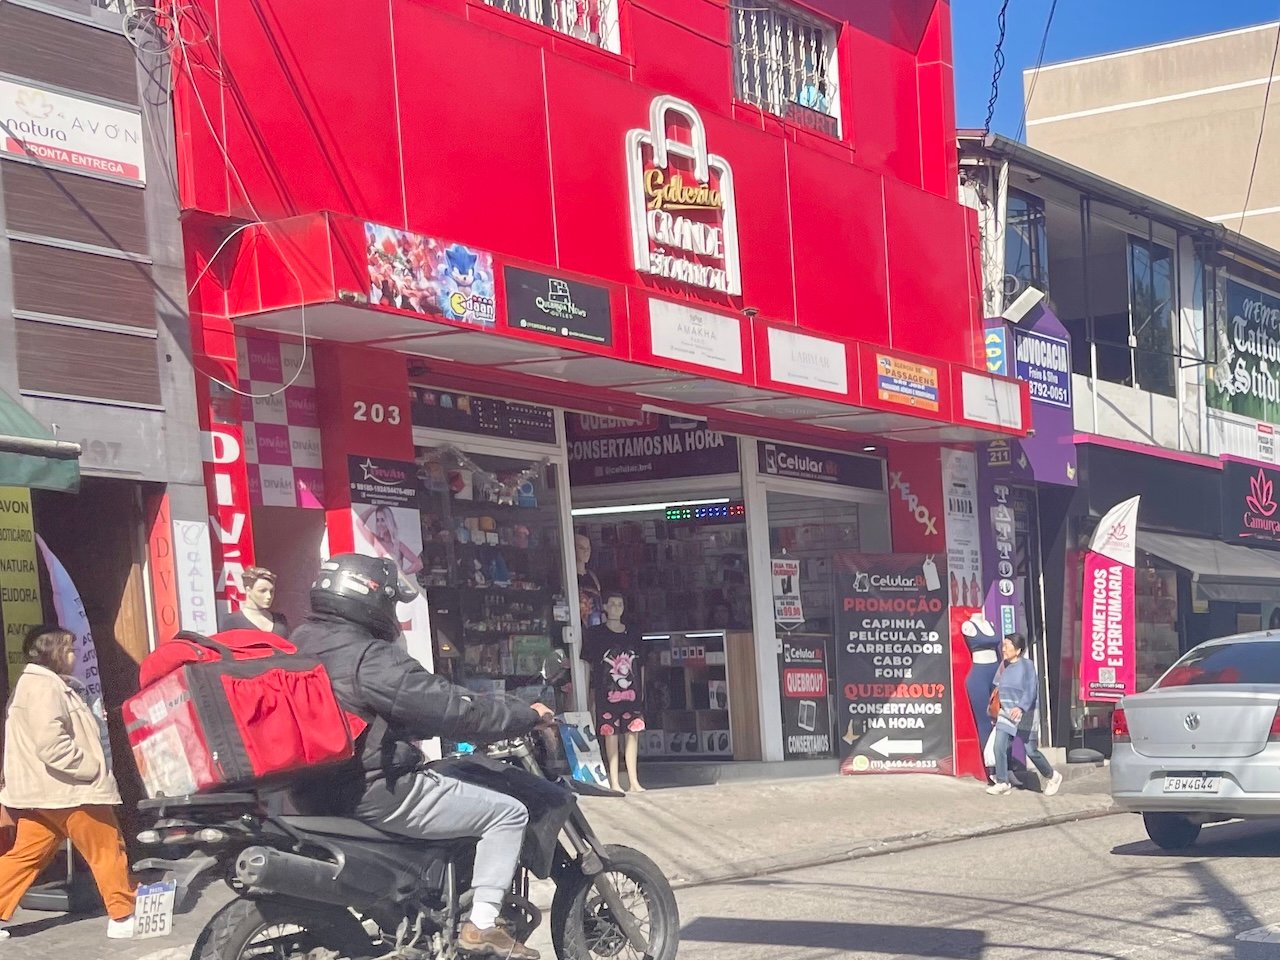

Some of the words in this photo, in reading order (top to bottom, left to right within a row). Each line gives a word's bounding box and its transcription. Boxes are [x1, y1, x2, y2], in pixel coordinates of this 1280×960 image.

[6, 118, 67, 141] natura
[25, 144, 69, 162] PRONTA
[71, 153, 125, 174] ENTREGA
[676, 322, 717, 340] AMAKHA
[1017, 334, 1068, 373] ADVOCACIA
[885, 368, 935, 386] PASSAGENS
[353, 400, 401, 425] 203
[580, 409, 651, 431] QUEBU?
[566, 433, 663, 461] CONSERTAMOS
[662, 433, 682, 455] NA
[685, 428, 725, 452] HORA
[777, 452, 823, 473] Celular
[990, 452, 1008, 462] 211
[0, 501, 29, 514] AVON
[890, 471, 938, 536] XEROX
[1243, 511, 1280, 535] Camurça
[993, 484, 1015, 597] TATTOO
[1, 559, 35, 573] NATURA
[2, 588, 38, 602] EUDORA
[843, 595, 942, 618] PROMOÇÃO
[1091, 568, 1107, 662] COSMETICOS
[1107, 565, 1123, 656] PERFUMARIA
[7, 624, 30, 636] AVO
[861, 618, 926, 629] CAPINHA
[849, 629, 917, 641] PELÍCULA
[920, 631, 940, 642] 3D
[846, 643, 943, 654] CARREGADOR
[873, 655, 913, 666] CABO
[1108, 657, 1123, 667] E
[874, 668, 913, 678] FONE
[786, 672, 824, 693] QUEBROU?
[844, 683, 945, 700] QUEBROU?
[848, 703, 943, 714] CONSERTAMOS
[867, 717, 887, 729] NA
[888, 718, 926, 729] HORA
[788, 735, 829, 753] CONSERTAMOS
